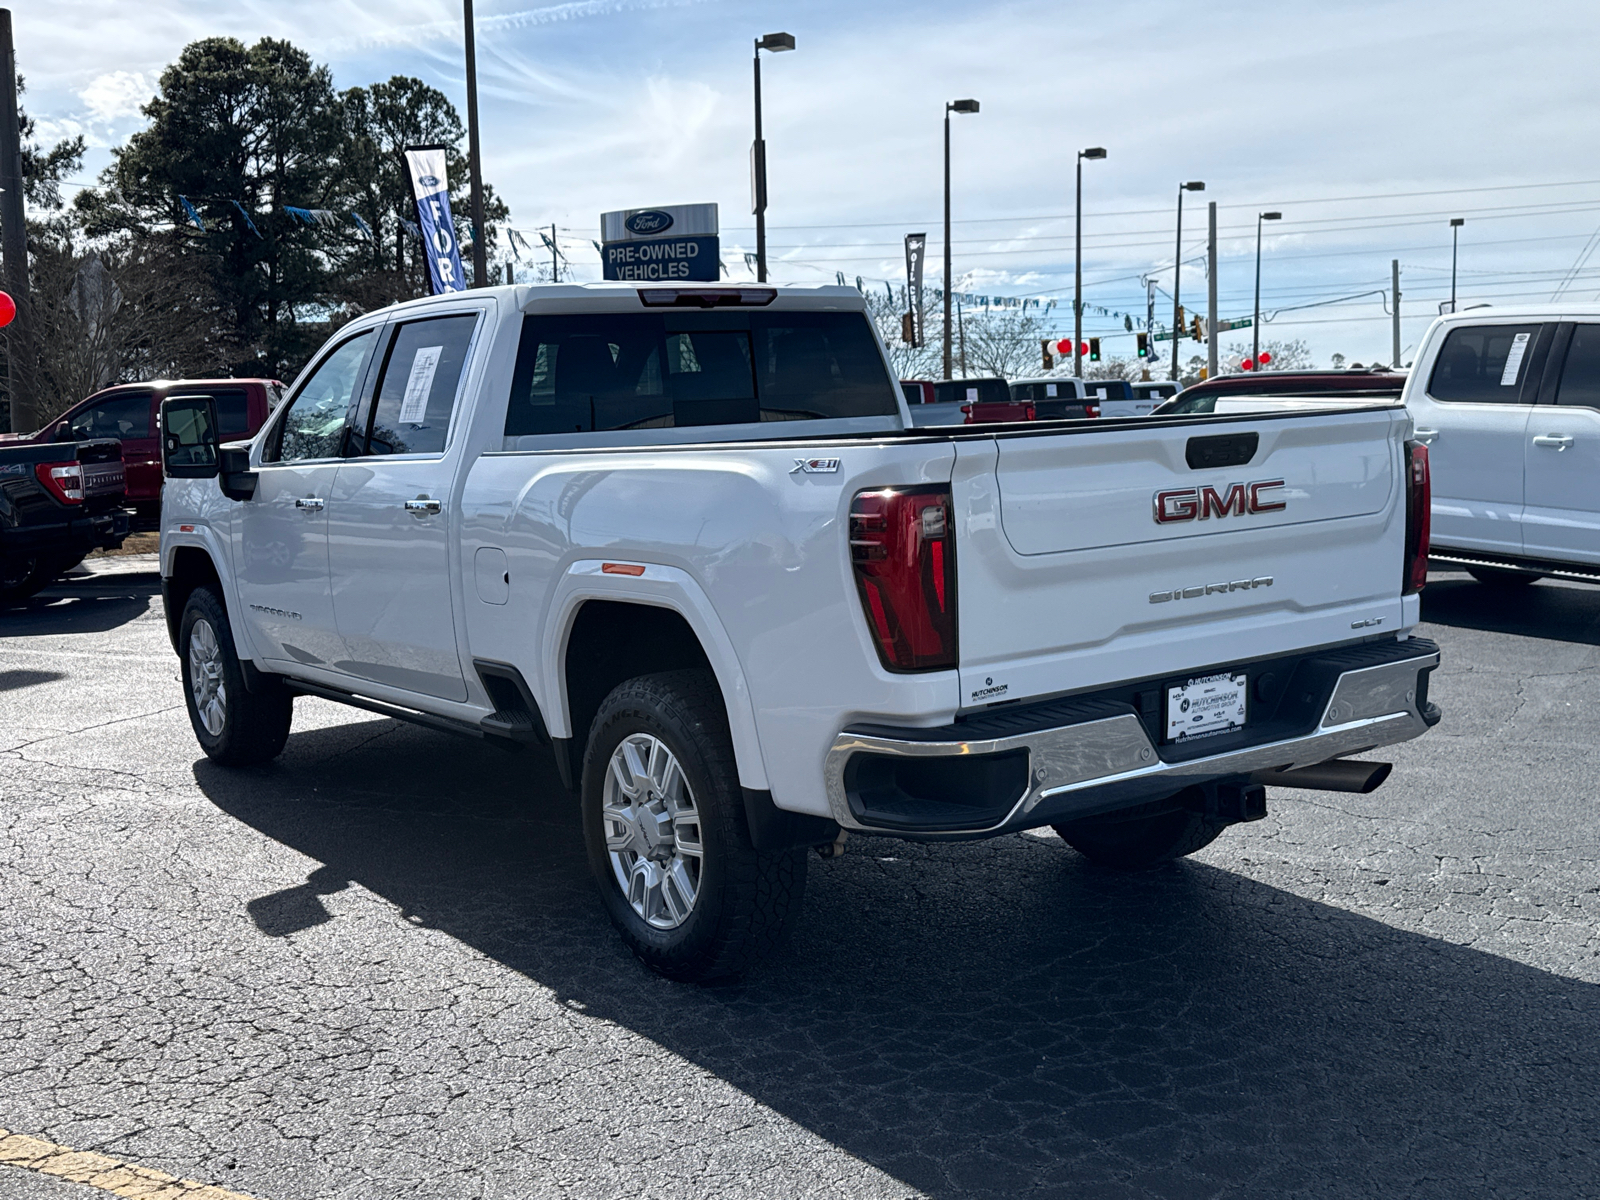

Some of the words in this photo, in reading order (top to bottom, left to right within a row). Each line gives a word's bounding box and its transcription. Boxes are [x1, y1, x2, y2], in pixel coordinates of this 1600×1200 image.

[634, 215, 661, 230] Ford
[609, 242, 699, 264] PRE-OWNED
[616, 261, 690, 280] VEHICLES
[910, 252, 918, 282] OIL
[1152, 477, 1287, 525] GMC
[1149, 576, 1274, 605] SIERRA
[1350, 615, 1387, 629] SLT
[1194, 672, 1232, 685] HUTCHINSON
[972, 684, 1008, 698] HUTCHINSON
[1191, 690, 1239, 708] HUTCHINSON
[1191, 703, 1220, 714] AUTOMOTIVE
[1220, 699, 1237, 708] GROUP
